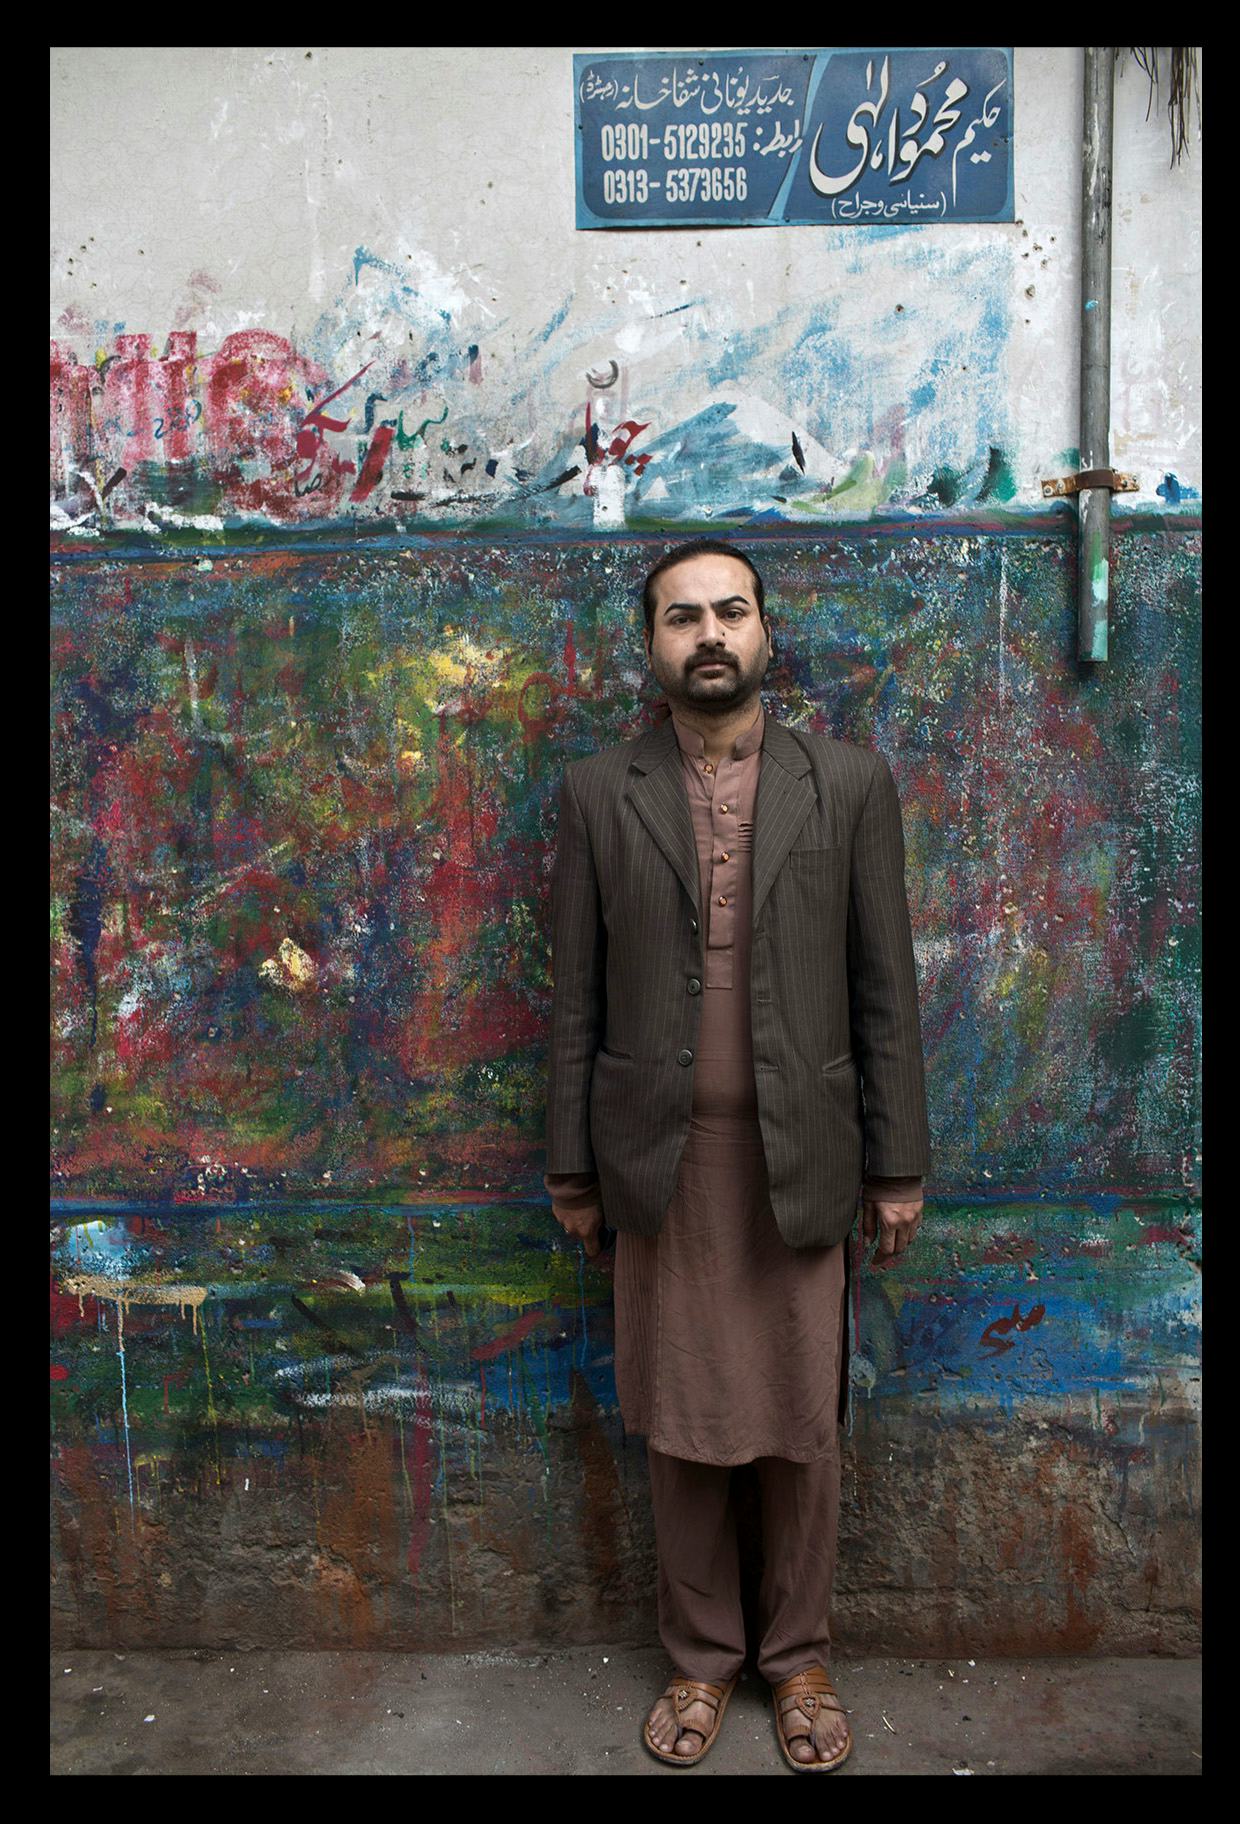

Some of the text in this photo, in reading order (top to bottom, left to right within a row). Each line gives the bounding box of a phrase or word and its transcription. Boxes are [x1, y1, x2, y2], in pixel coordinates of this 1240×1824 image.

[745, 75, 795, 114] جدید
[601, 121, 748, 162] 0301-5129235
[952, 78, 1007, 208] حکیم
[603, 166, 748, 205] 0313-5373656
